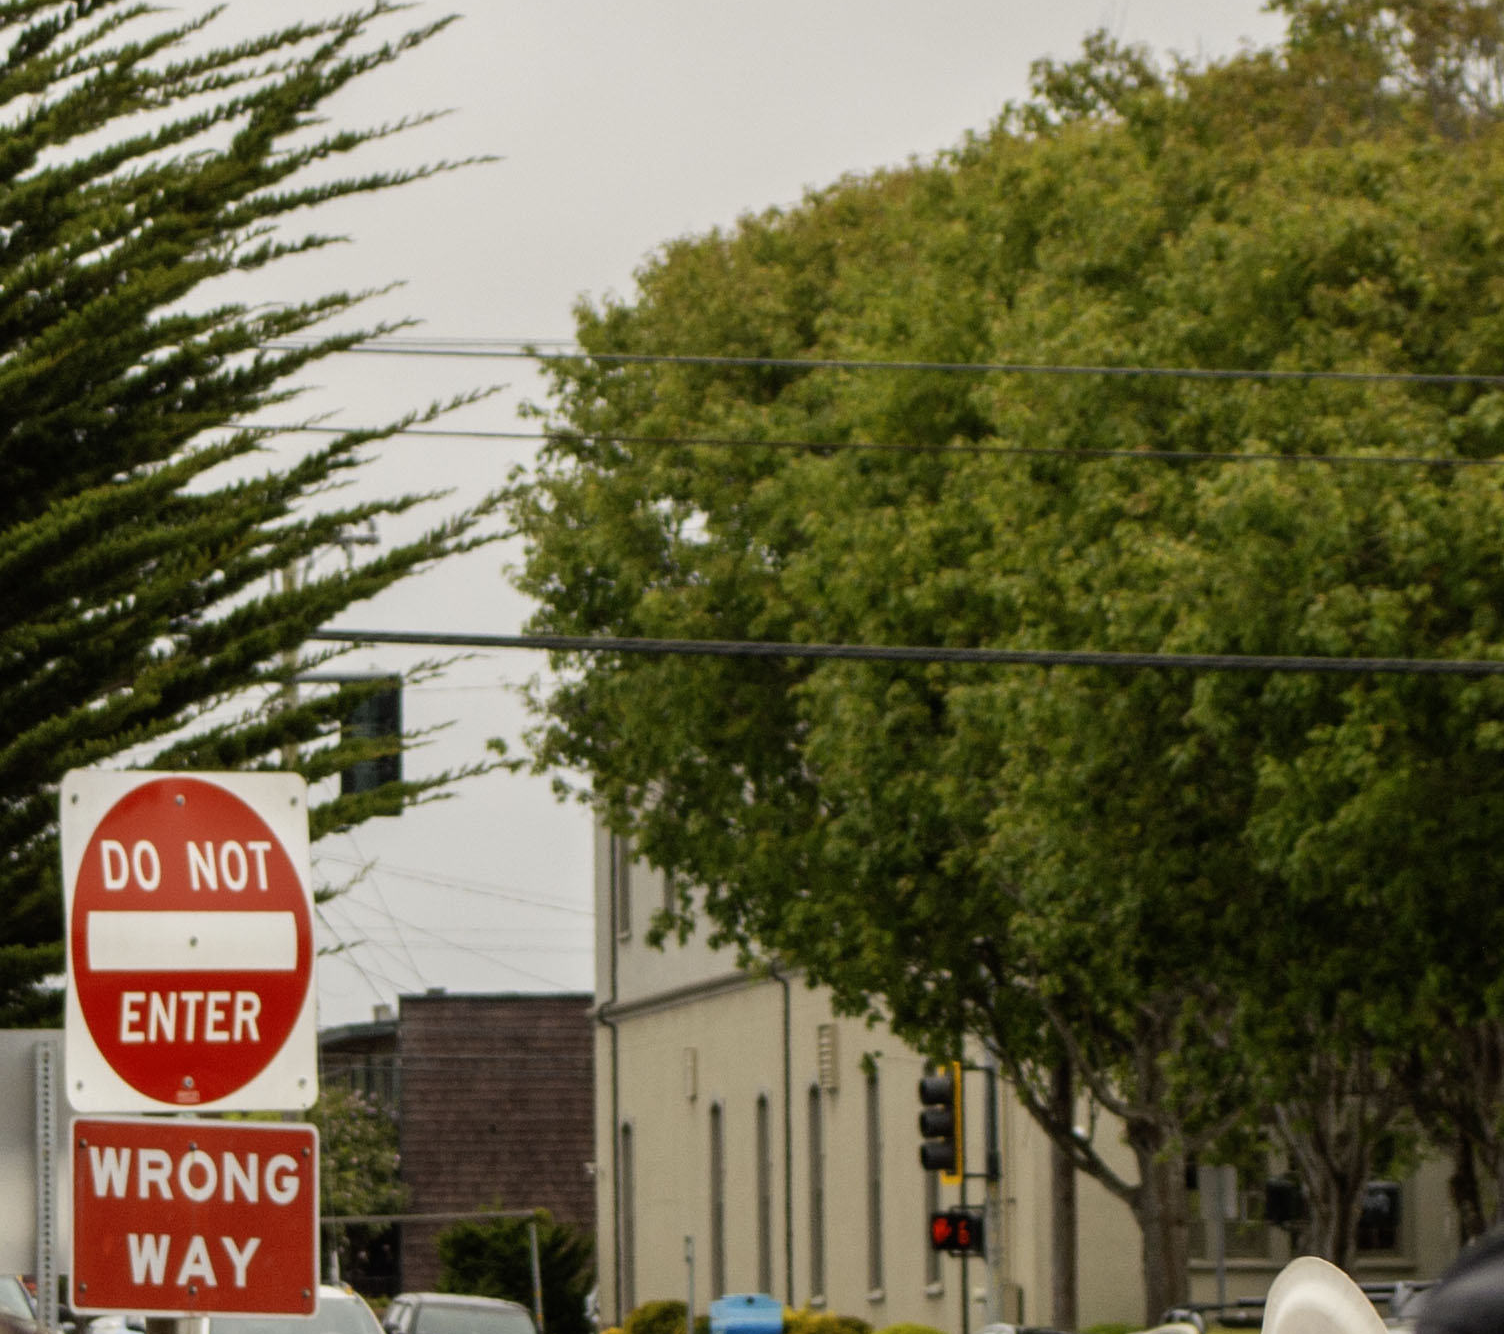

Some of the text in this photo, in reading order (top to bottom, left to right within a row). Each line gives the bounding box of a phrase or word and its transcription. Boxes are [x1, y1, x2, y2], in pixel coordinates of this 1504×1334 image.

[99, 839, 272, 892] DO NOT
[119, 990, 262, 1043] ENTER
[89, 1145, 300, 1206] WRONG
[127, 1232, 262, 1289] WAY
